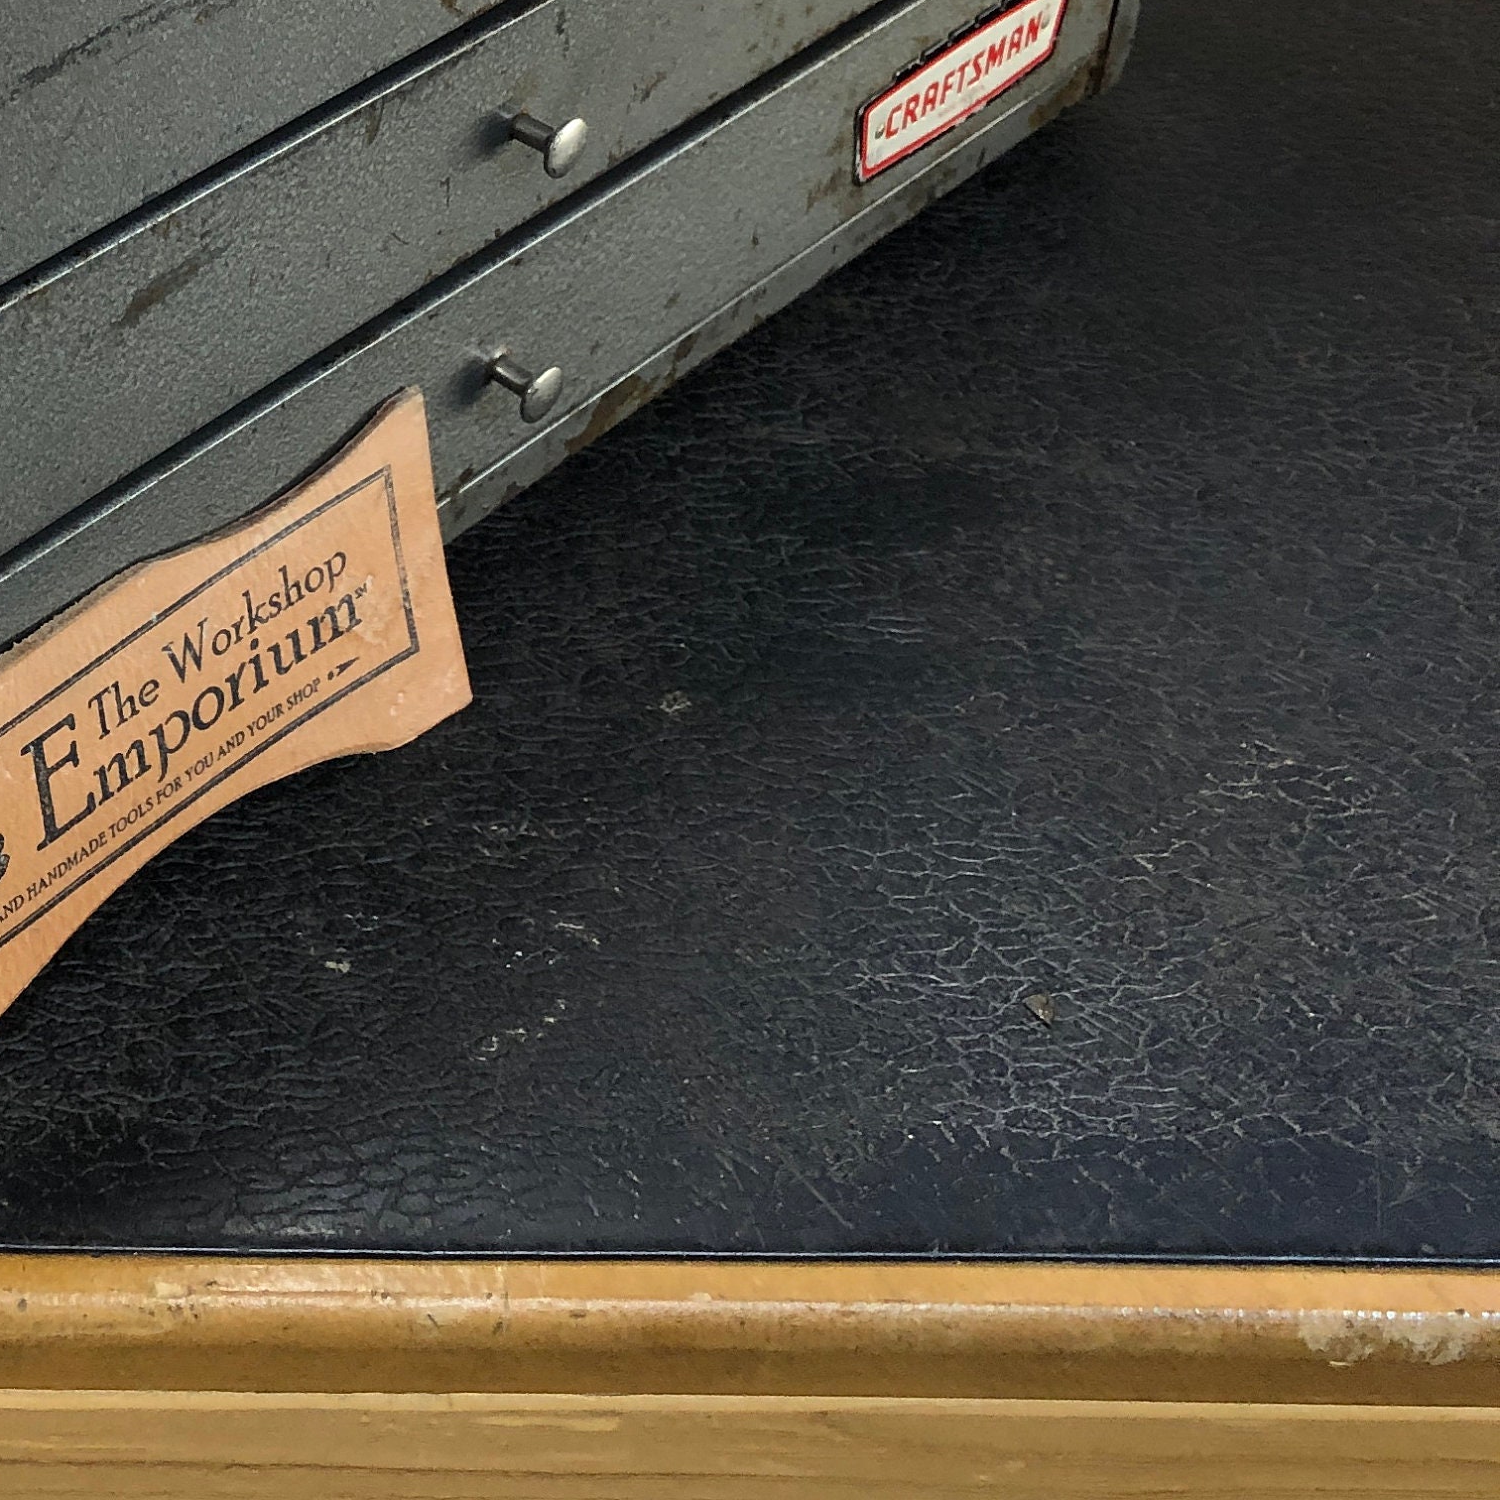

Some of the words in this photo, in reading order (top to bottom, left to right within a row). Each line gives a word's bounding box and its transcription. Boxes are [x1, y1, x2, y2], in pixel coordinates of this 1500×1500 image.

[884, 10, 1044, 139] CRAFTSMAN
[21, 593, 363, 852] Emporium
[88, 678, 160, 740] The
[162, 551, 347, 684] Workshop
[26, 831, 108, 902] HANDMADE
[109, 796, 155, 839] TOOLS
[156, 775, 183, 805] FOR
[184, 751, 215, 782] YOU
[217, 730, 245, 762] AND
[247, 702, 285, 737] YOUR
[286, 677, 321, 711] SHOP
